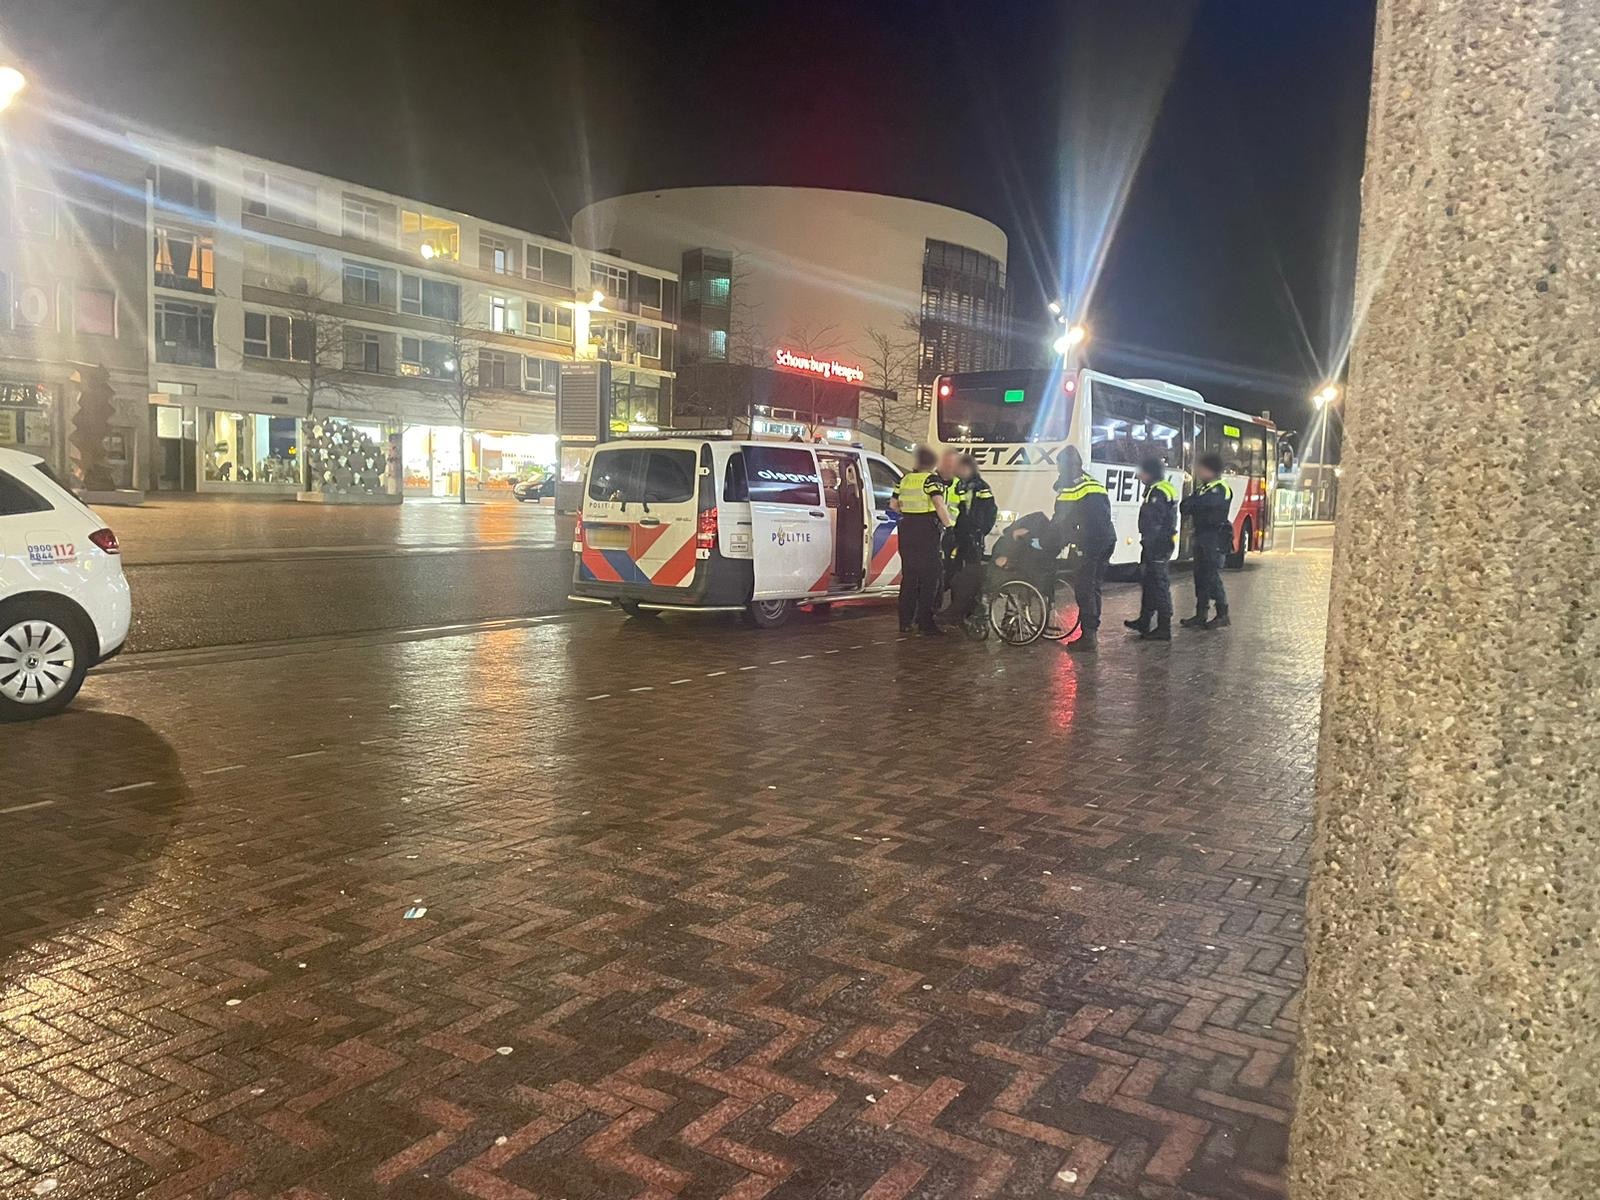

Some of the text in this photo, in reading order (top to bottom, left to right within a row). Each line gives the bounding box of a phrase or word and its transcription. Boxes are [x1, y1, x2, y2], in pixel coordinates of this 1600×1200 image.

[776, 349, 864, 382] Schouwburg Hengelo
[954, 447, 1059, 465] IETAX
[771, 531, 811, 545] POLITIE
[53, 543, 75, 556] 112
